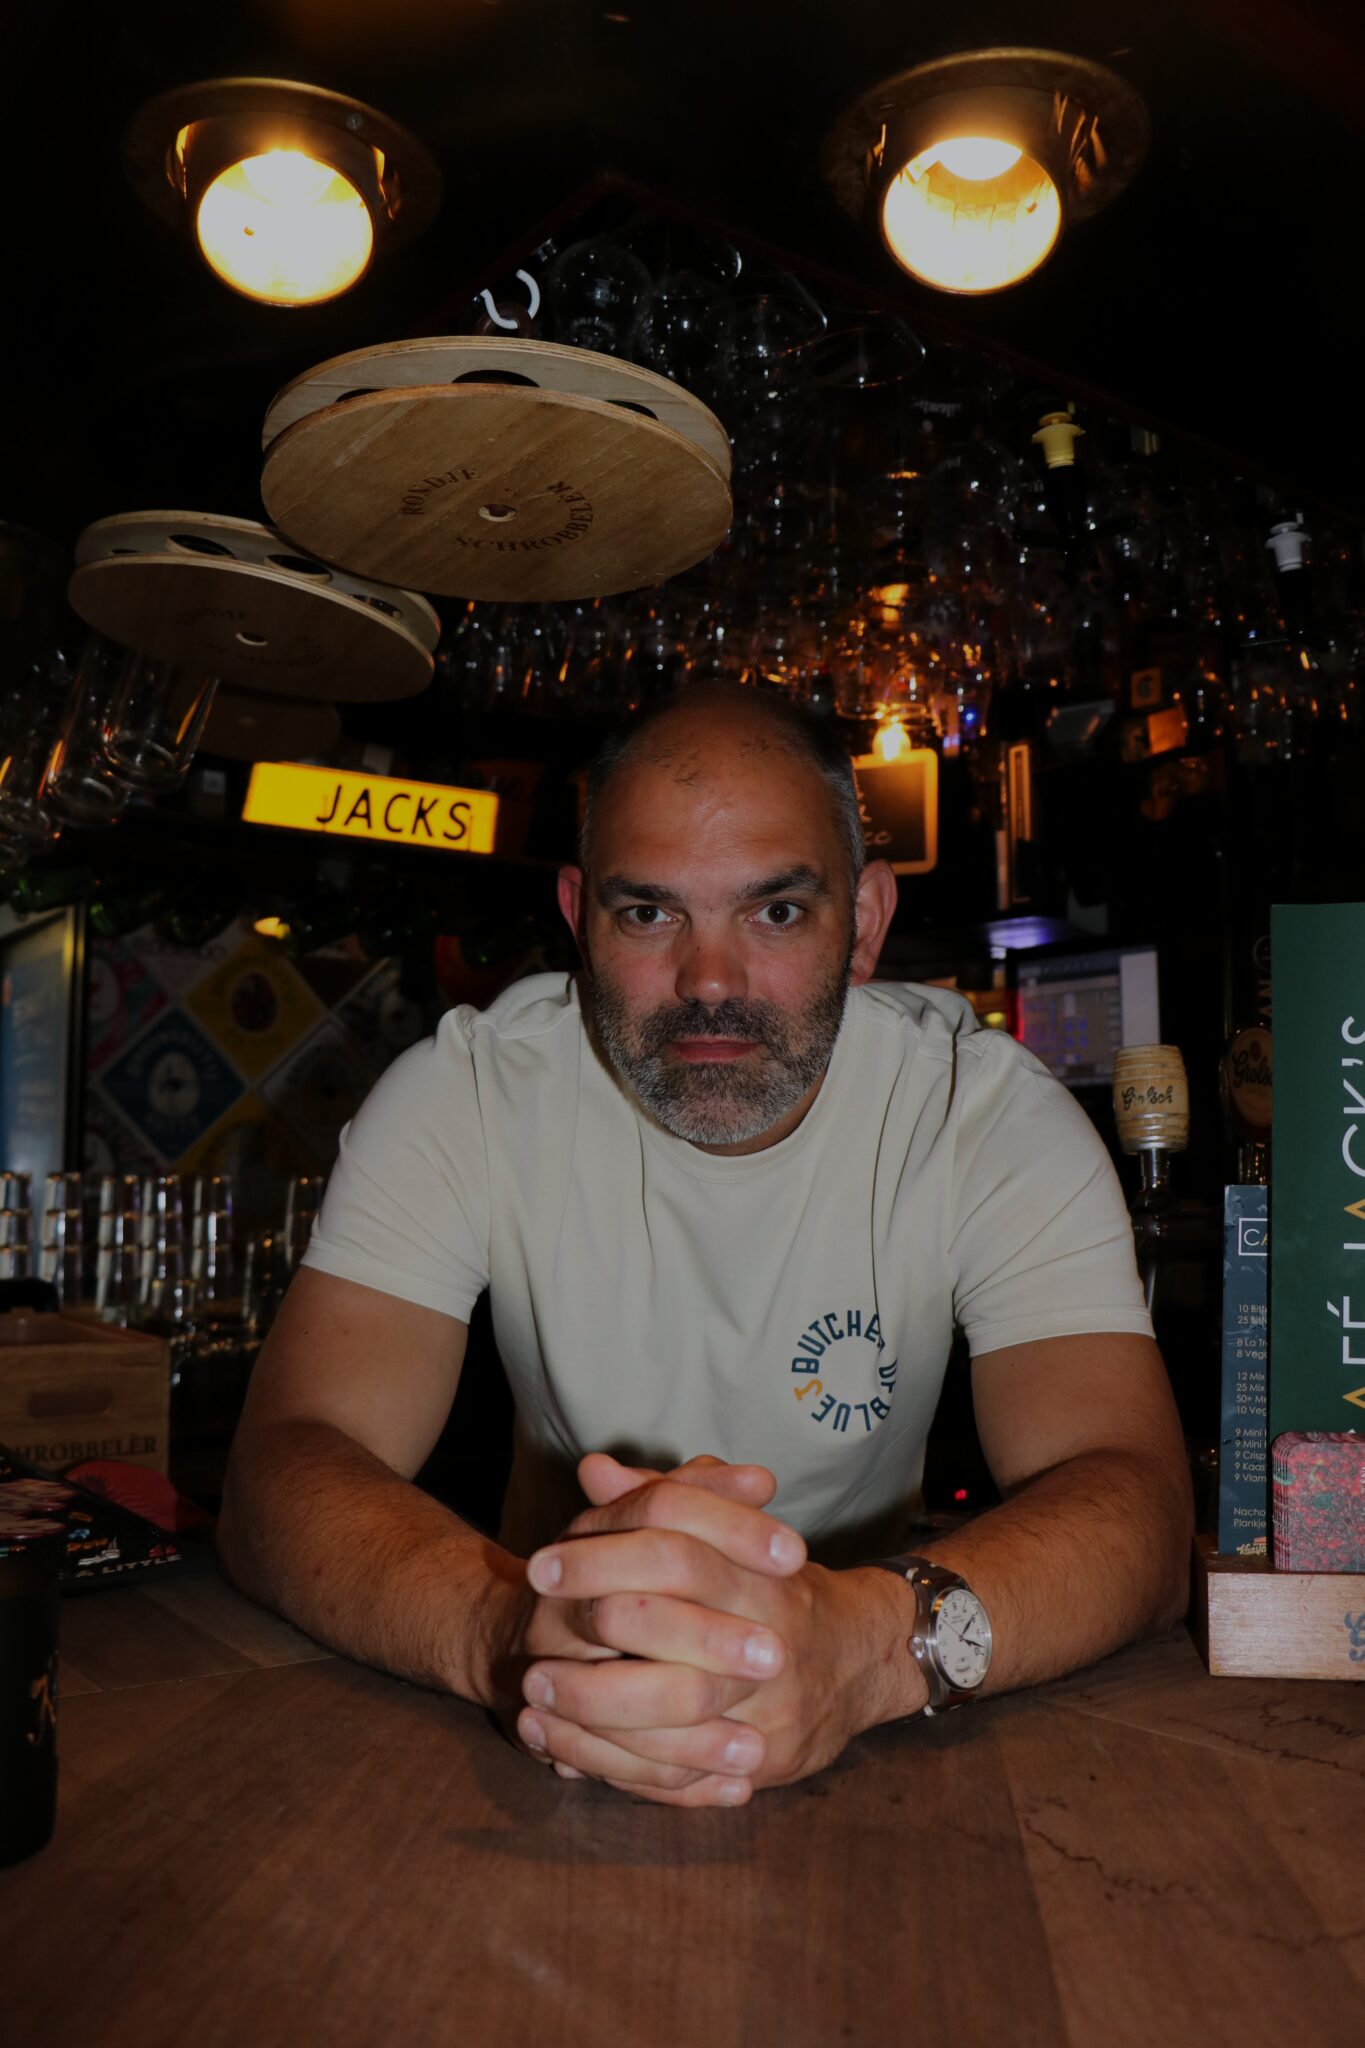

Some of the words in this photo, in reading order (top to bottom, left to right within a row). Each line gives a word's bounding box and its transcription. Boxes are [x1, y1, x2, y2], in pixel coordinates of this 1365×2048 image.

[401, 468, 482, 515] RONDJE
[316, 784, 471, 841] JACKS
[1121, 1085, 1174, 1111] Golsch
[1238, 1304, 1249, 1313] 10
[1237, 1315, 1249, 1325] 25
[1236, 1338, 1243, 1347] 8
[1244, 1338, 1256, 1347] La
[1236, 1349, 1243, 1358] 8
[1237, 1371, 1248, 1381] 12
[1249, 1372, 1265, 1381] Mix
[1236, 1383, 1247, 1392] 25
[1249, 1383, 1265, 1392] Mix
[1236, 1394, 1252, 1403] 50+
[1237, 1405, 1247, 1415] 10
[1242, 1428, 1262, 1437] Mini
[1242, 1440, 1262, 1448] Mini
[1242, 1450, 1266, 1461] Crisp
[1242, 1462, 1266, 1471] Kaas
[1233, 1507, 1266, 1516] Nacho
